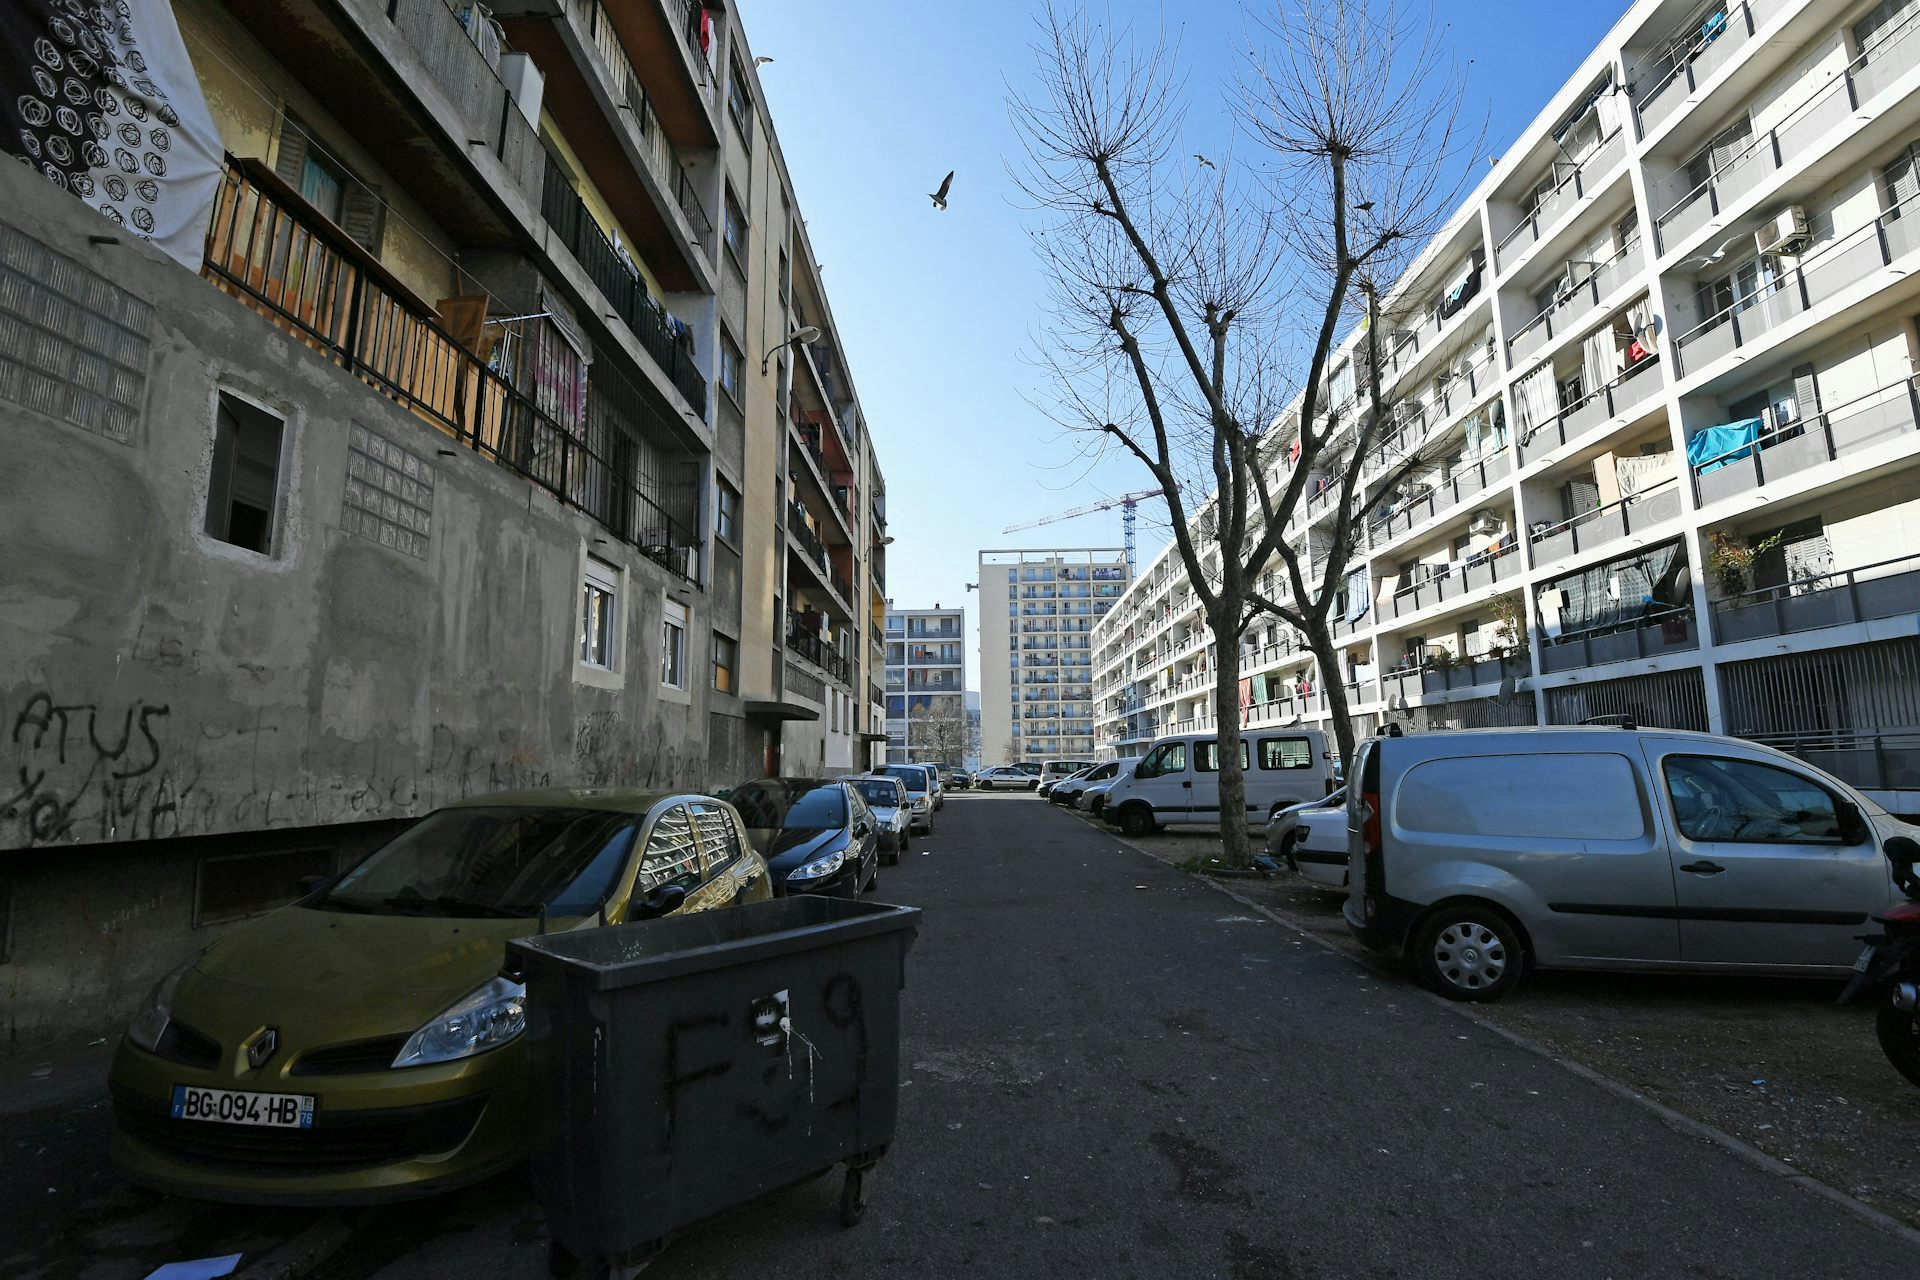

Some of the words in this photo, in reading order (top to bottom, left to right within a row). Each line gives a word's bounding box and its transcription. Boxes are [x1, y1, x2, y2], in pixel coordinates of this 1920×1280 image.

[13, 691, 170, 780] ATUS
[185, 1090, 298, 1125] BG-094-HB
[301, 1112, 312, 1125] 76
